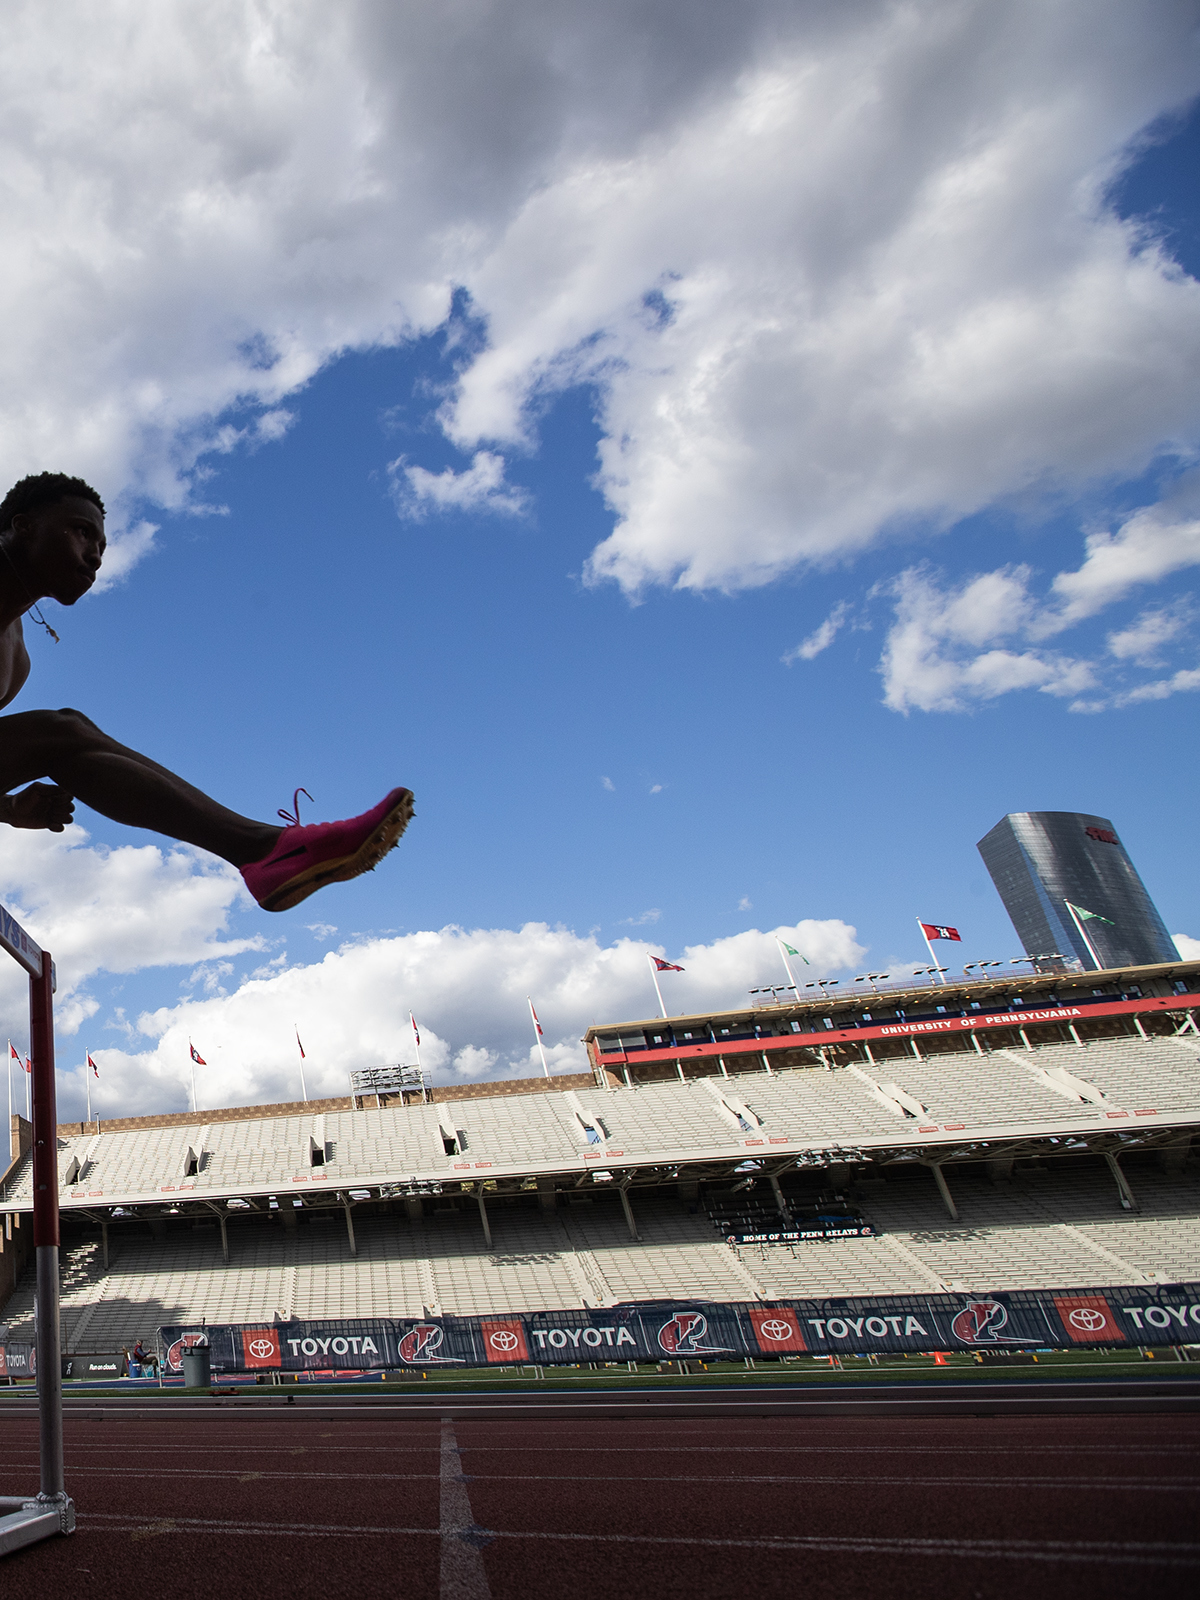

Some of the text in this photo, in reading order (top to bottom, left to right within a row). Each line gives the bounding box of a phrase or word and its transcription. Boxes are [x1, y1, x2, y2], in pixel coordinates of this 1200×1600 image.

[881, 1008, 1082, 1035] UNIVERSITY OF PENNSYLVANIA
[742, 1228, 858, 1243] HOME OF THE PENN RELAYS
[808, 1315, 928, 1338] TOYOTA
[287, 1336, 379, 1356] TOYOTA
[532, 1327, 637, 1348] TOYOTA
[6, 1354, 26, 1367] TOYOTA
